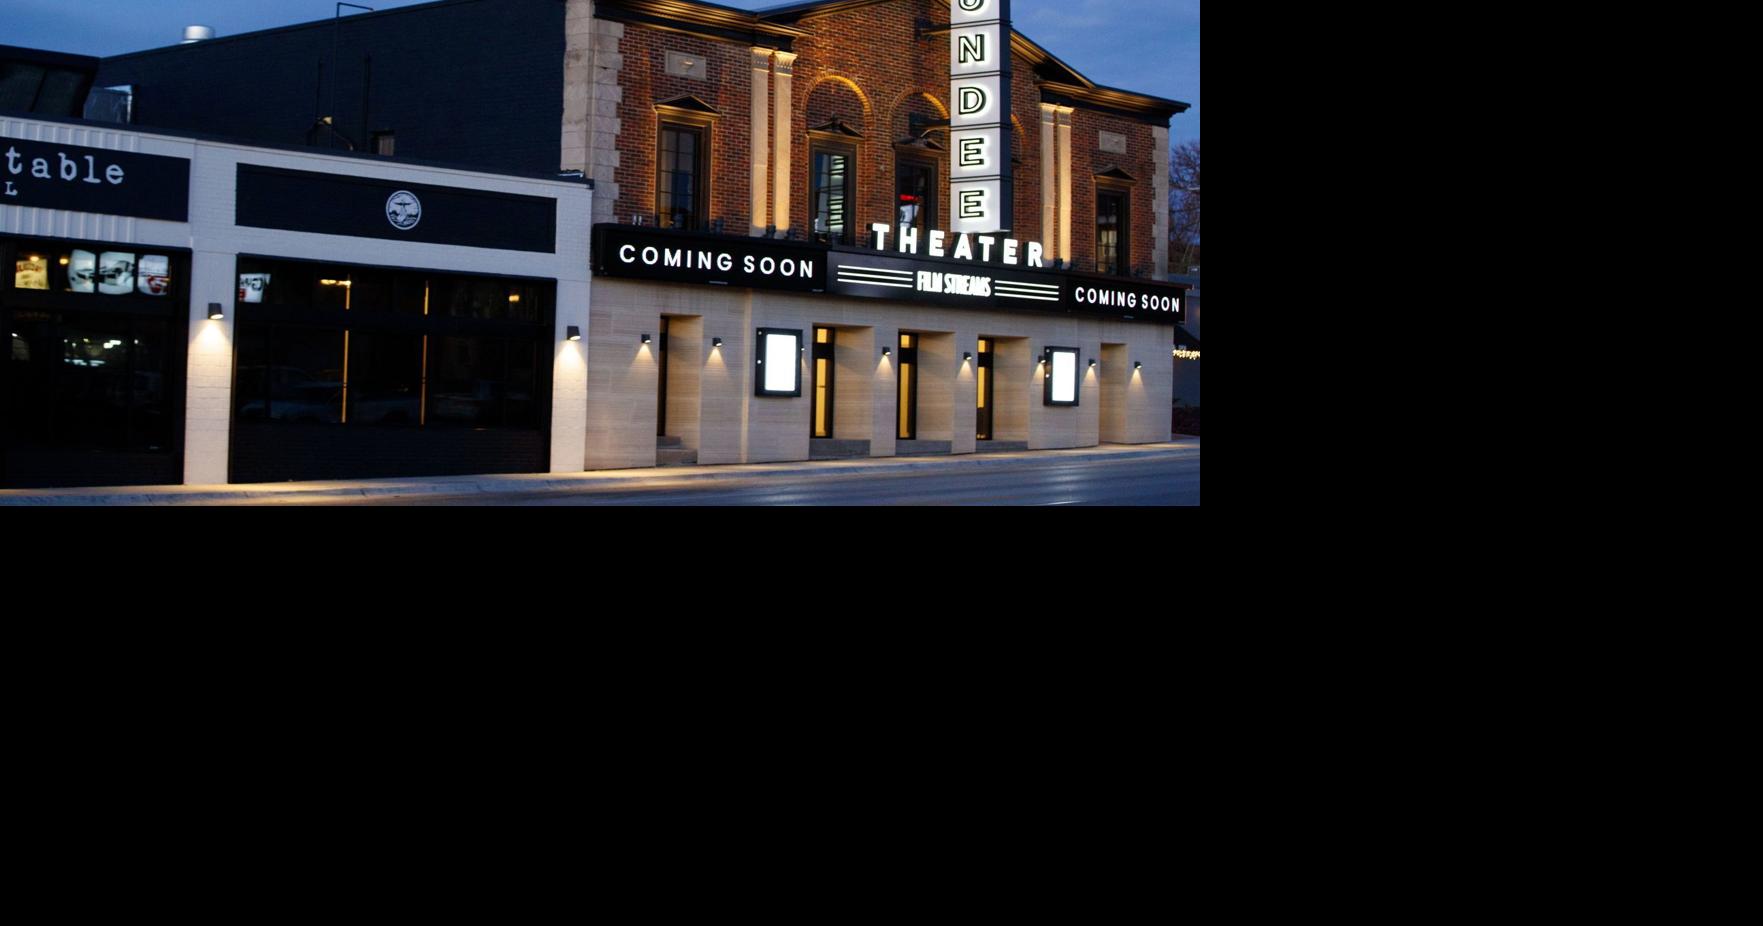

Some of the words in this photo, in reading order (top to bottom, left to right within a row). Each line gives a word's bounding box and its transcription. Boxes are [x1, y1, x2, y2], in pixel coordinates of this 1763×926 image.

[5, 146, 125, 184] table
[619, 244, 733, 271] COMING
[743, 255, 814, 278] SOON
[872, 222, 1043, 268] THEATER
[917, 270, 943, 293] FILM
[944, 273, 991, 297] STREAMS
[1075, 286, 1137, 308] COMING
[1141, 294, 1180, 313] SOON
